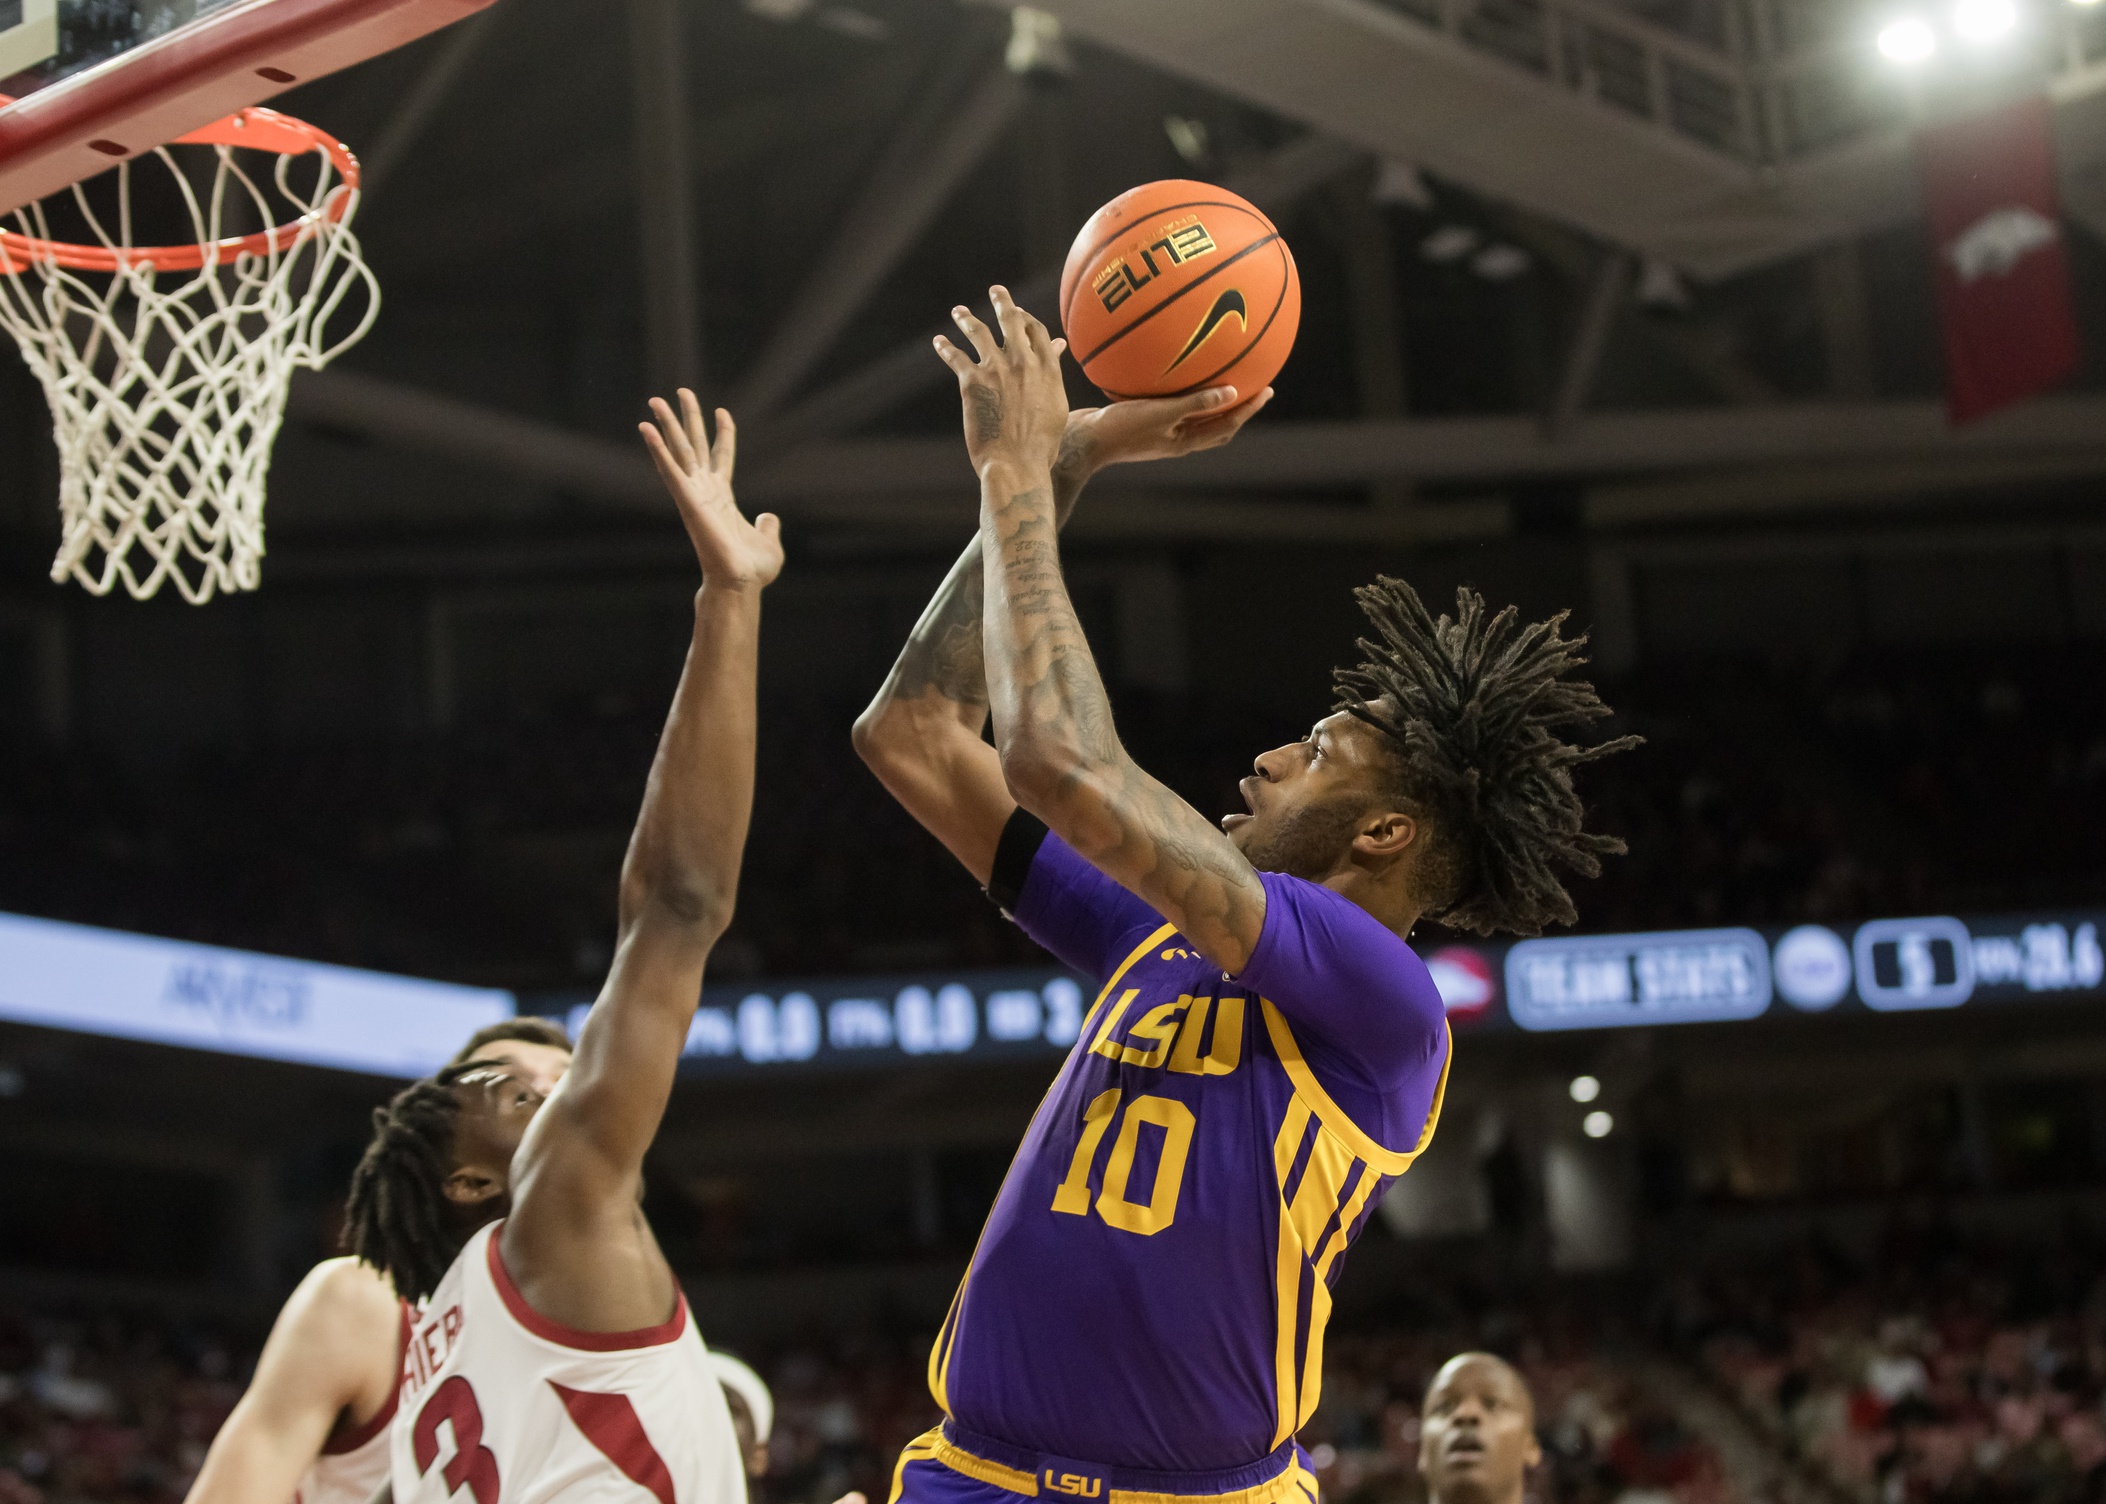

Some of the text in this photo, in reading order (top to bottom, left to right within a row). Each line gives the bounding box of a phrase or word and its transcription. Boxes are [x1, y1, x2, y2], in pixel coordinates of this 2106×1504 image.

[1097, 219, 1216, 314] ELITE
[1088, 989, 1246, 1076] LSU
[1051, 1088, 1196, 1236] 10
[412, 1375, 500, 1504] 3
[1044, 1469, 1101, 1498] LSU
